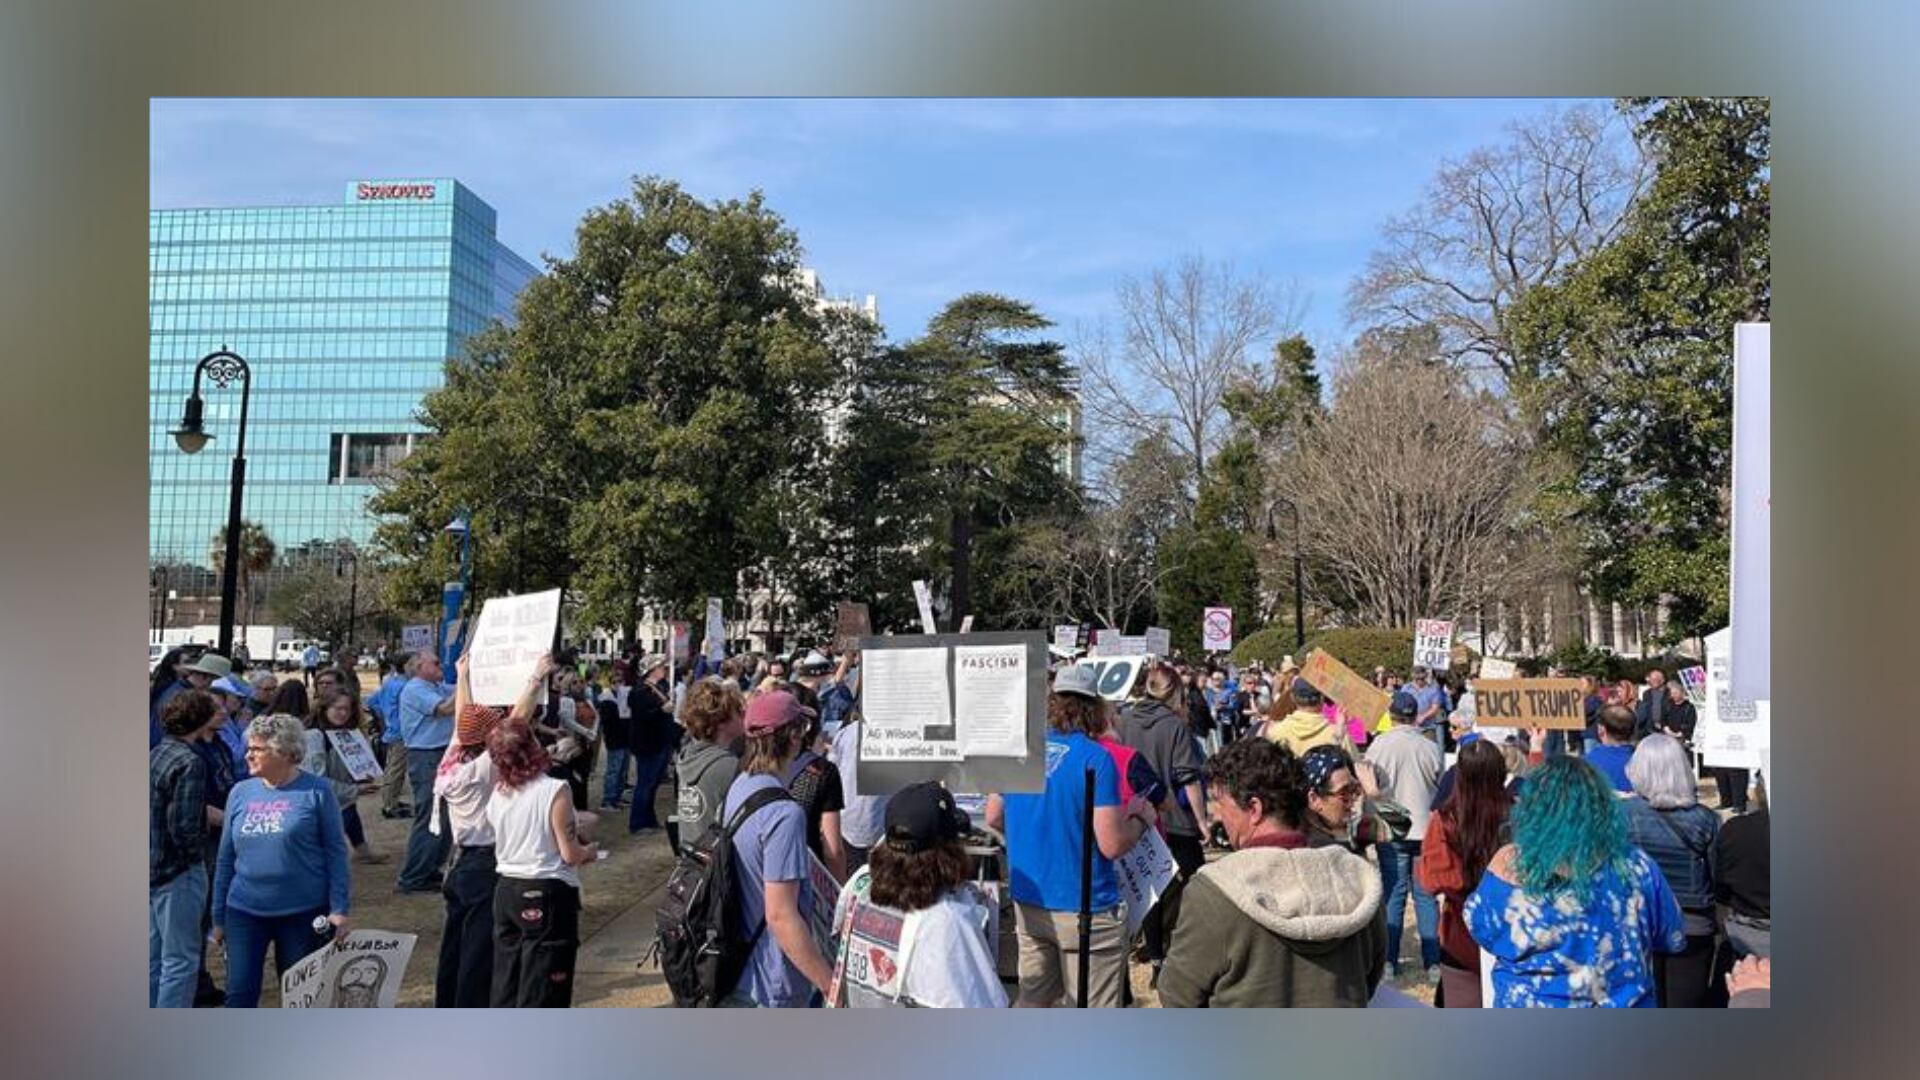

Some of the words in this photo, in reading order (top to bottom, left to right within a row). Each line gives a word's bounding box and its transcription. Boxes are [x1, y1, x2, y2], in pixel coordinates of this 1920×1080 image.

[1419, 636, 1447, 648] THE
[961, 657, 1019, 669] FASCISM
[1475, 688, 1522, 718] FUCK
[1525, 687, 1581, 718] TRUMP
[867, 728, 881, 739] AG
[885, 727, 922, 741] Wilson,
[864, 746, 882, 757] this
[885, 746, 894, 757] is
[898, 746, 934, 757] settled
[284, 959, 320, 993] LOVE
